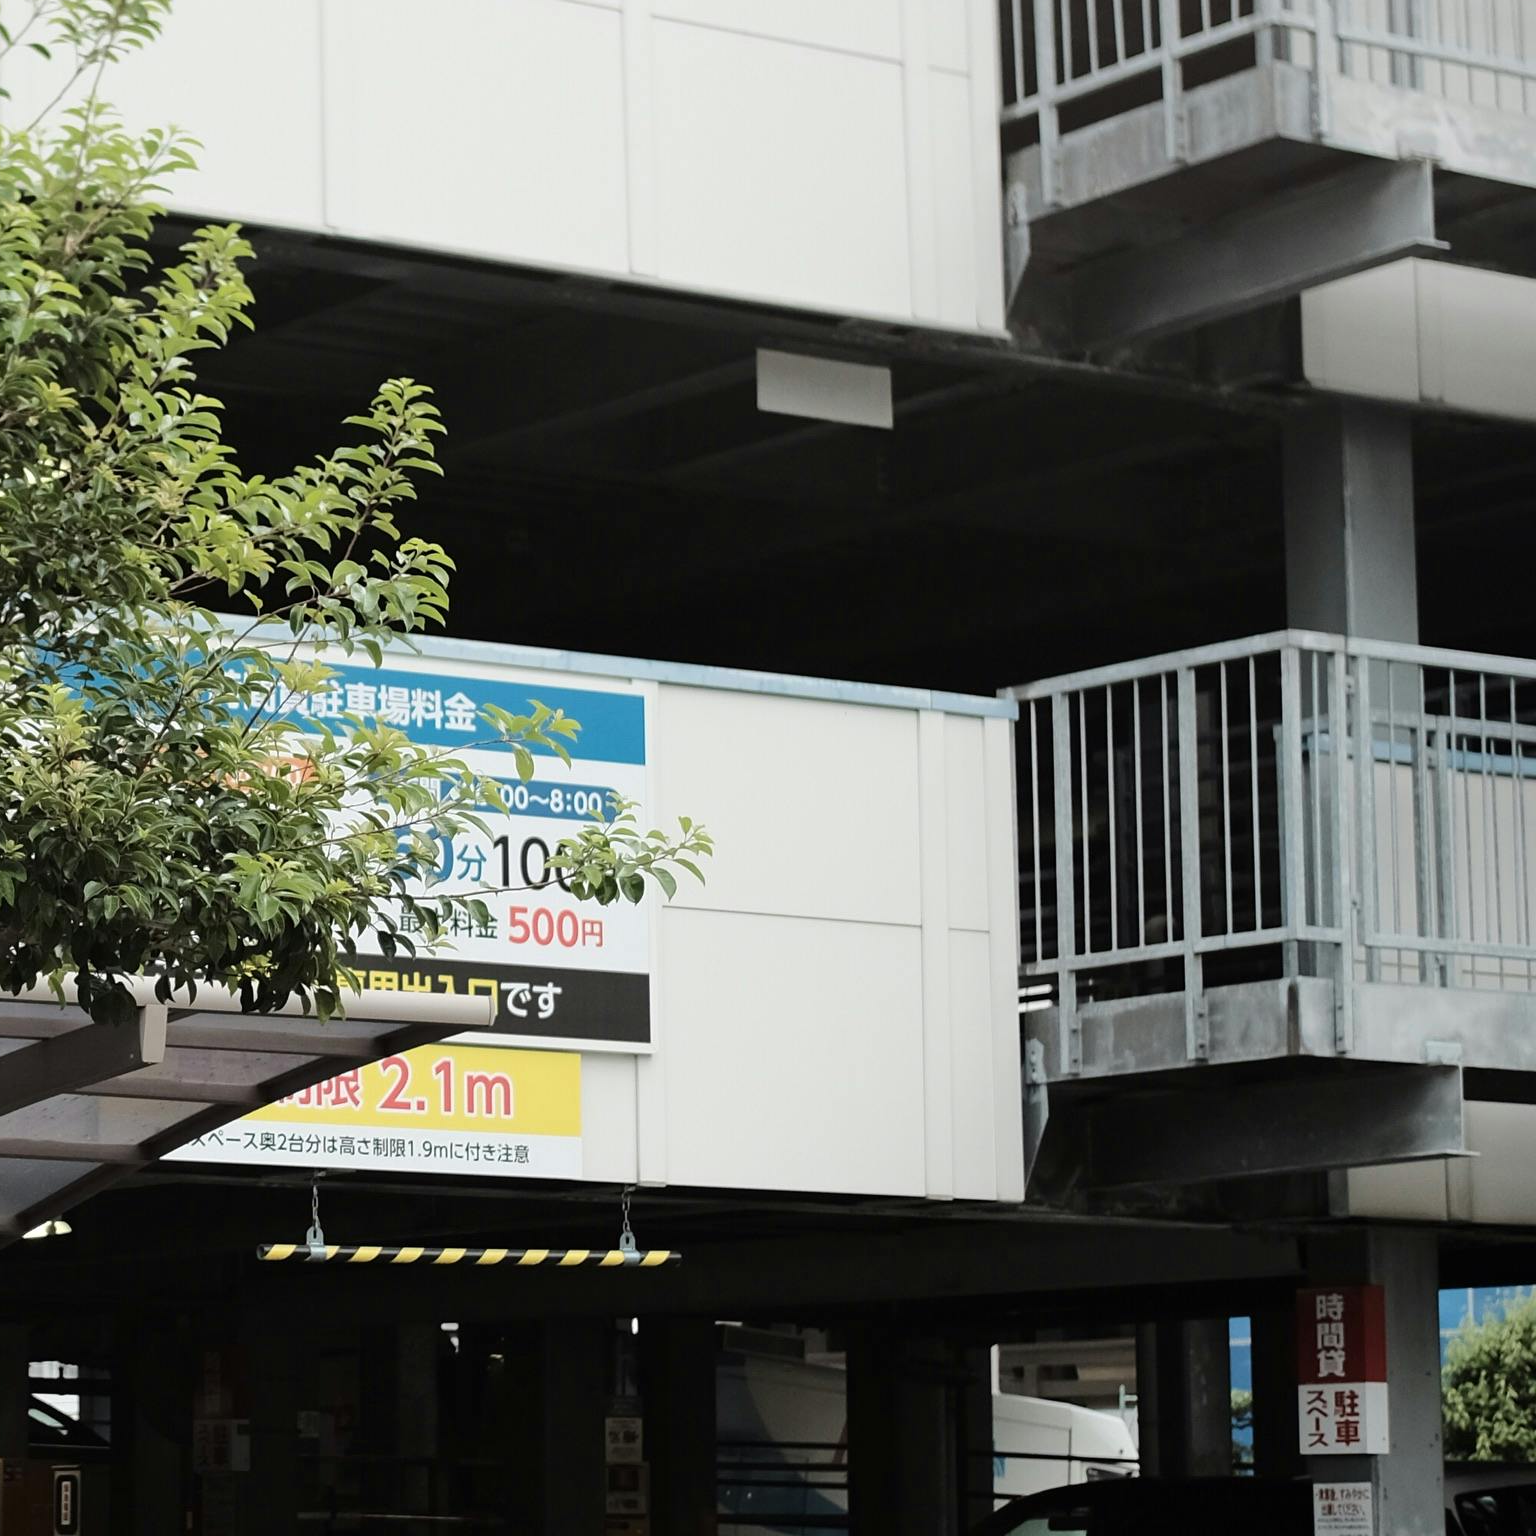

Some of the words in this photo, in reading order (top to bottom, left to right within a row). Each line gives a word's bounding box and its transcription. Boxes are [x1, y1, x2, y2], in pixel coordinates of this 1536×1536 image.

[399, 904, 498, 940] 最料金
[508, 905, 604, 948] 500円
[379, 1055, 512, 1116] 2.1m
[1315, 1293, 1346, 1378] 時間貸
[1307, 1390, 1329, 1447] スペース
[1334, 1390, 1361, 1446] 駐車
